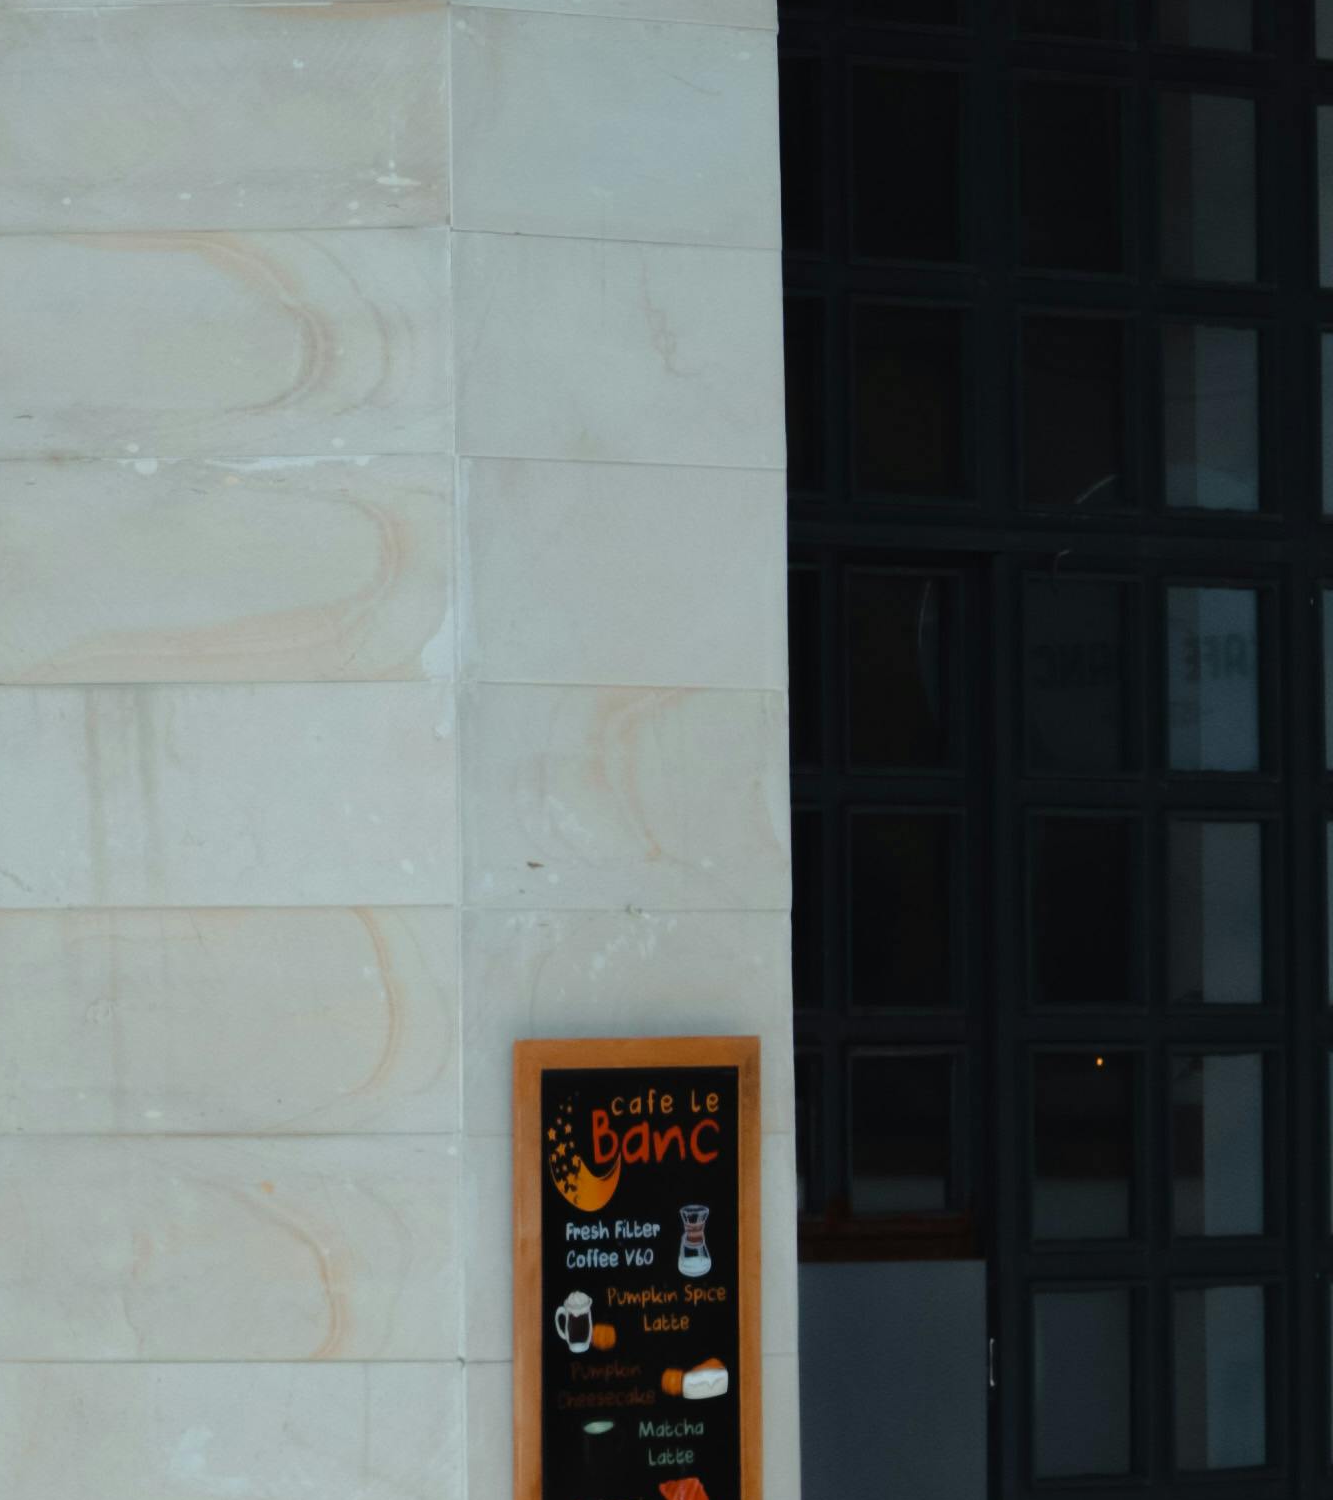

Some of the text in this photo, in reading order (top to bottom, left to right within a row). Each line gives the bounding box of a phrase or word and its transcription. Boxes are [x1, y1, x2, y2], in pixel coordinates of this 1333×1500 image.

[565, 1218, 661, 1241] Fresh Filter
[566, 1248, 654, 1269] Coffee V60
[606, 1283, 726, 1308] Pumpkin Spice
[643, 1313, 690, 1332] Latte
[638, 1418, 705, 1439] Matcha
[648, 1447, 695, 1467] Latte
